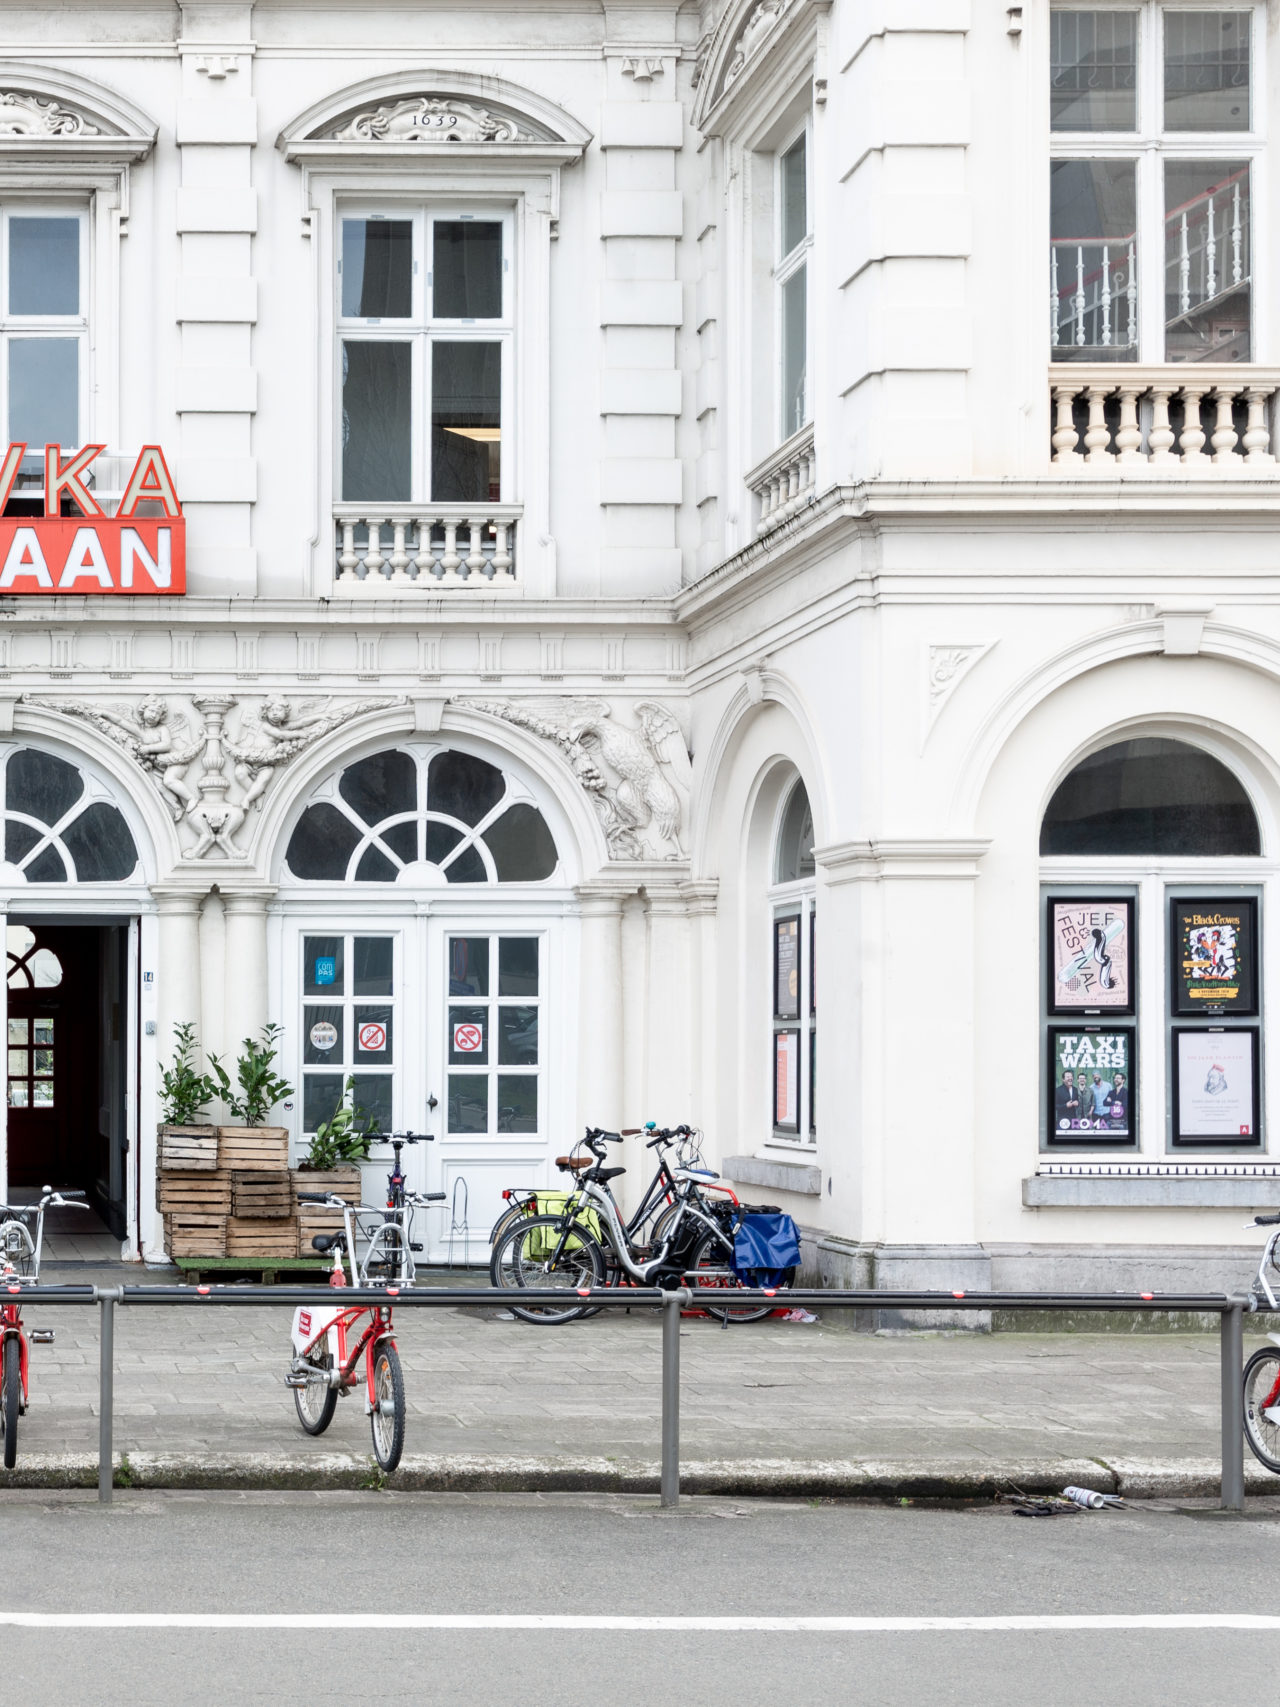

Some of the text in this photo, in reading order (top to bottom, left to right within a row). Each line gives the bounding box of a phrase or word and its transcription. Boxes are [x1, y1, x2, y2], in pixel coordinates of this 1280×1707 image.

[413, 114, 458, 129] 1639
[1193, 914, 1214, 925] Black
[1214, 913, 1240, 925] Crowes
[1057, 915, 1097, 993] FESTIVAL
[144, 972, 153, 982] 14
[1059, 1036, 1125, 1054] TAXI
[1059, 1053, 1125, 1068] WARS
[1071, 1118, 1110, 1130] ROMA
